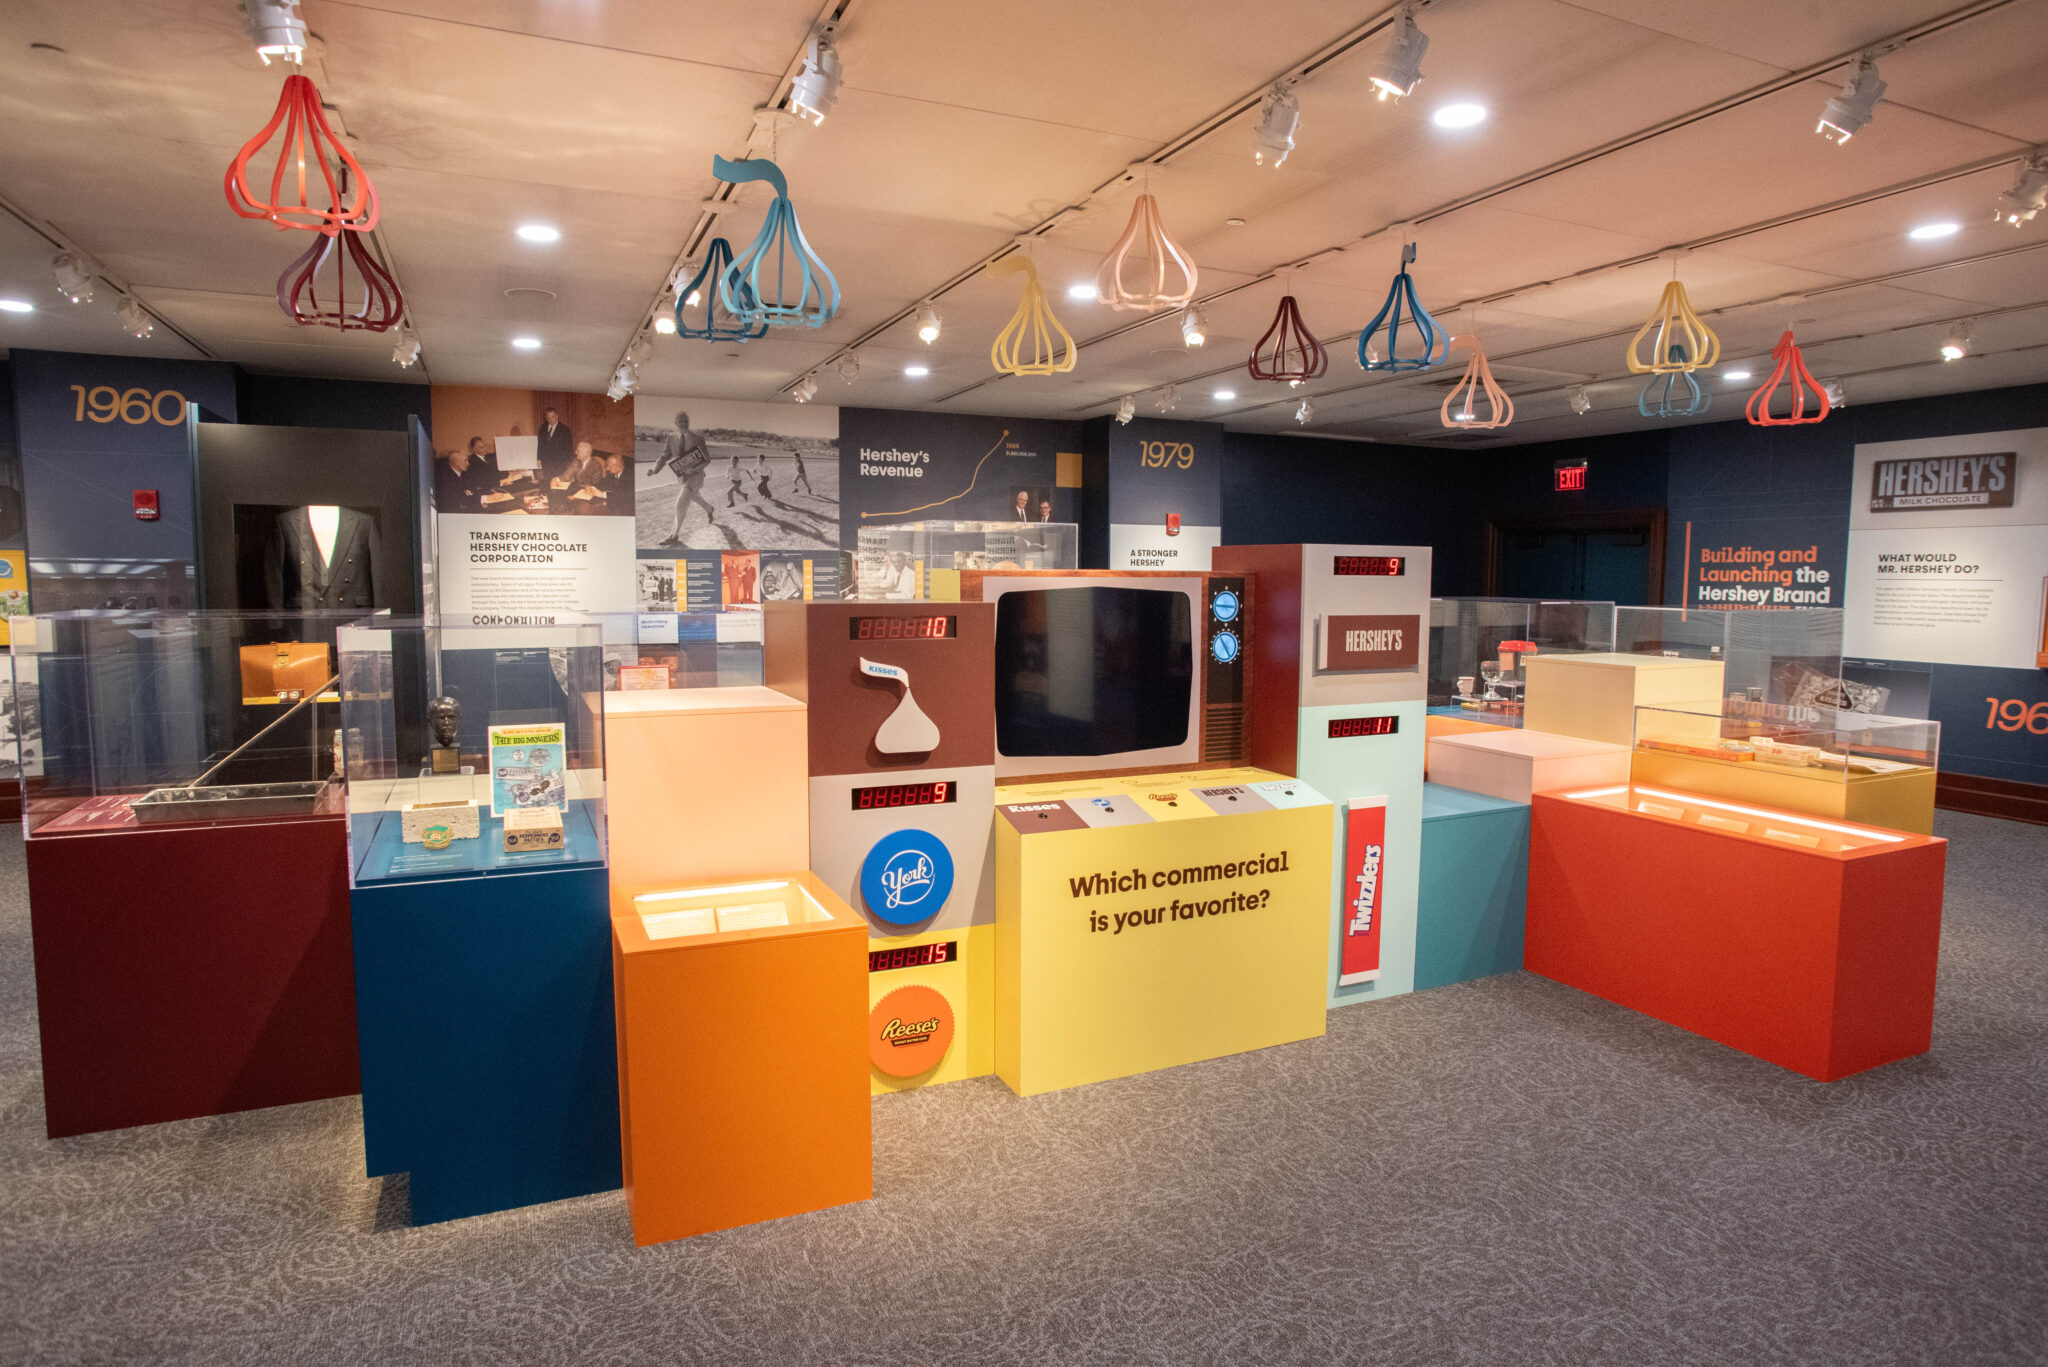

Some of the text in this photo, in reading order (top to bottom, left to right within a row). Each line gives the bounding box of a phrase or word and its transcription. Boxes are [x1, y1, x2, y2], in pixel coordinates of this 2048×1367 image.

[71, 385, 187, 426] 1960
[860, 447, 930, 466] Hershey's
[1140, 440, 1194, 469] 1979
[860, 463, 924, 478] Revenue
[1559, 468, 1582, 488] EXIT
[1878, 455, 2007, 496] HERSHEY'S
[1899, 495, 1983, 505] MILK CHOCOLATE
[469, 531, 559, 541] TRANSFORMING
[470, 543, 588, 552] HERSHEY CHOCOLATE
[1130, 549, 1178, 557] A STRONGER
[1701, 545, 1818, 566] Building and
[1878, 553, 1957, 562] WHAT WOULD
[470, 554, 554, 563] CORPORATION
[1130, 559, 1165, 567] HERSHEY
[1388, 558, 1399, 576] 9
[1700, 565, 1830, 587] Launching the
[1877, 565, 1980, 574] MR. HERSHEY DO?
[1699, 585, 1831, 606] Hershey Brand
[926, 616, 948, 638] 10
[1345, 629, 1403, 652] HERSHEY'S
[1376, 717, 1393, 733] 11
[495, 733, 560, 745] THE BIG MOVERS
[933, 782, 948, 803] 9
[1201, 787, 1246, 797] HERSHEY'S
[881, 857, 934, 909] York
[1069, 850, 1289, 898] Which commercial
[1348, 844, 1382, 937] Twizzlers
[1089, 889, 1270, 935] is your favorite?
[927, 943, 948, 963] 15
[880, 1017, 941, 1041] Reese's
